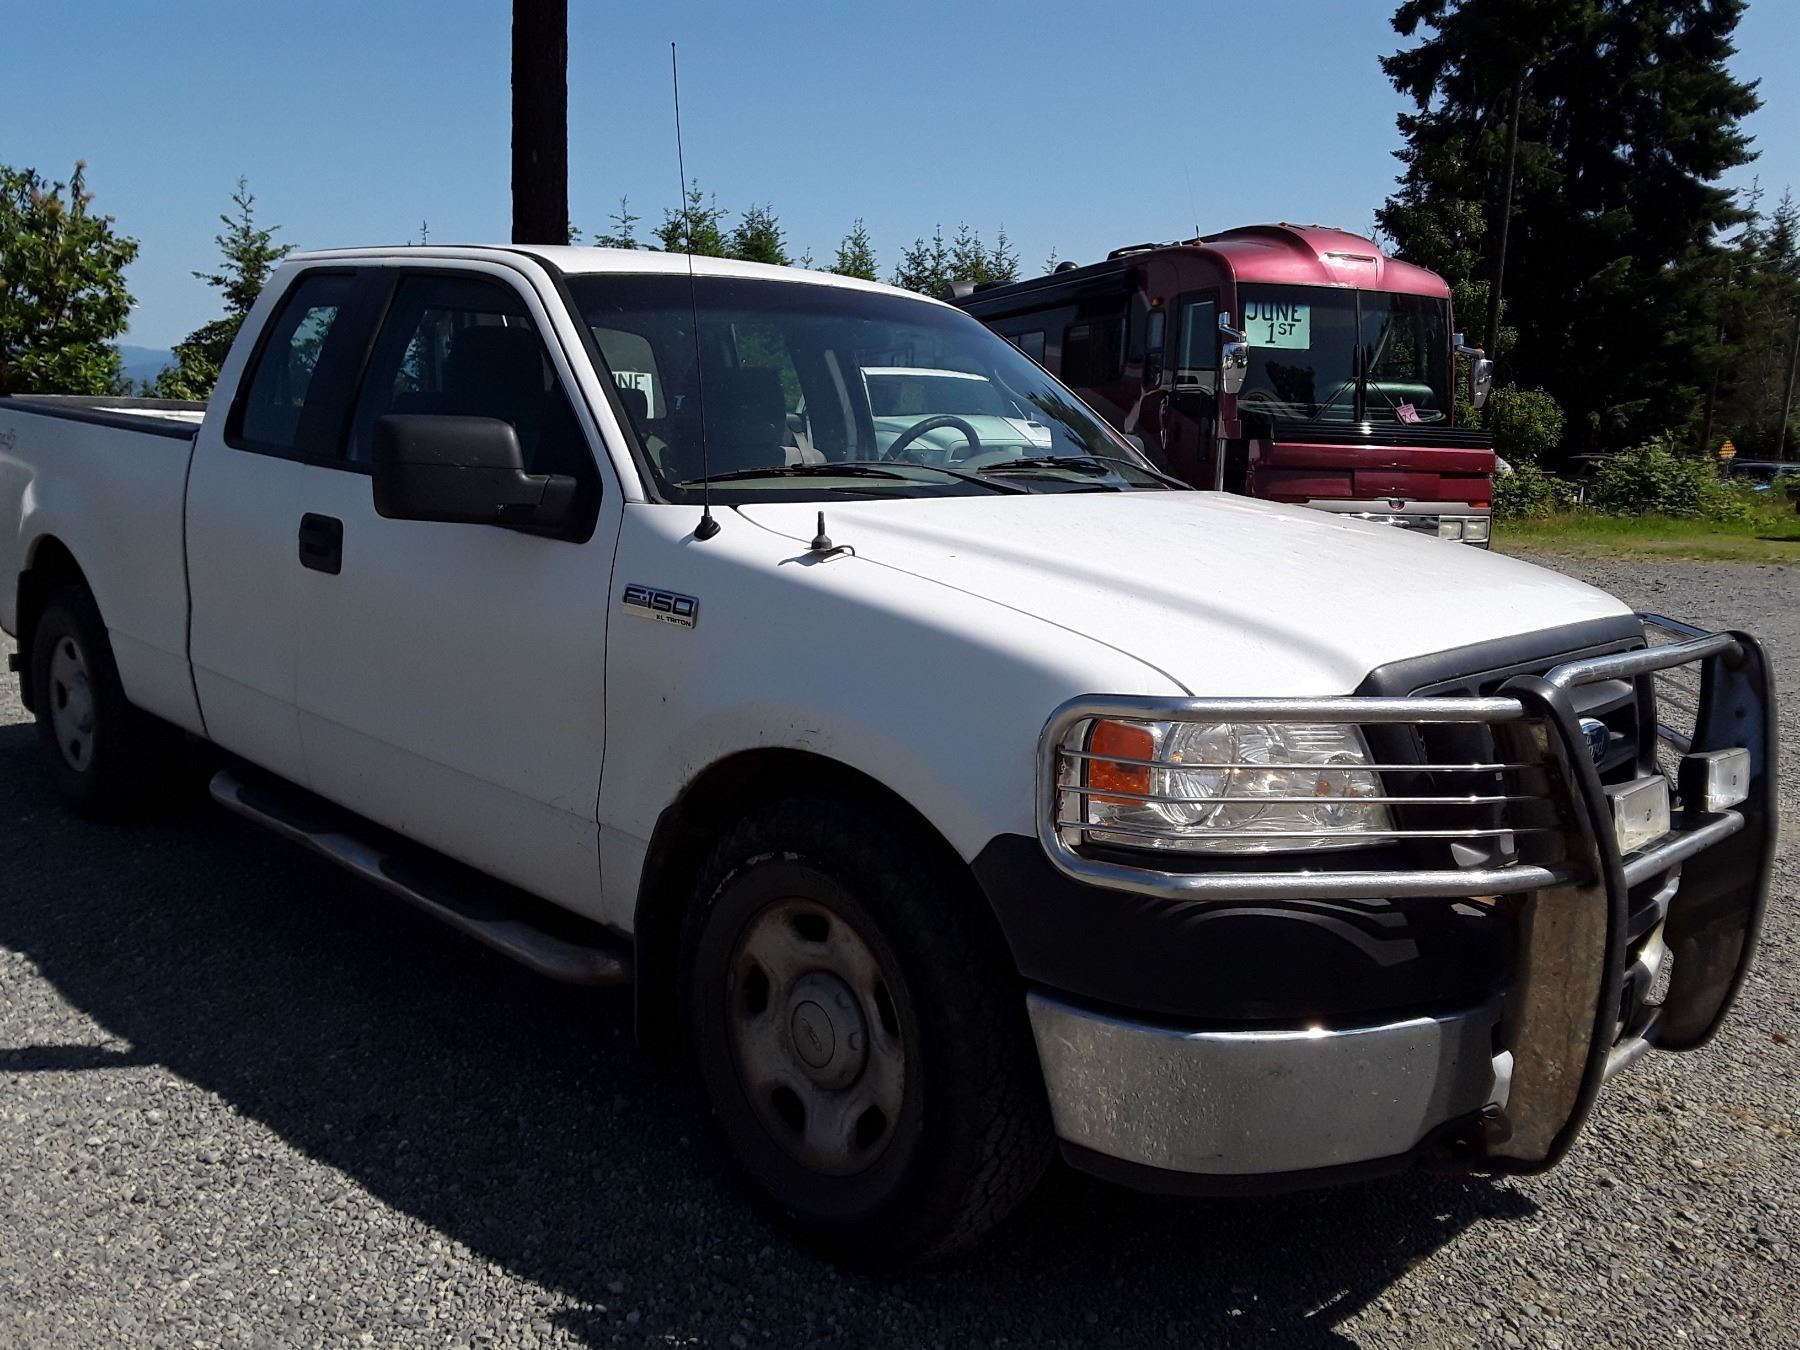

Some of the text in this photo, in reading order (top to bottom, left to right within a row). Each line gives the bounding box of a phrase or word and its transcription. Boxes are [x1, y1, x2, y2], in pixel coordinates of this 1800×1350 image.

[1246, 301, 1302, 322] JUNE
[1265, 322, 1296, 344] 1ST
[666, 616, 691, 627] TRITON
